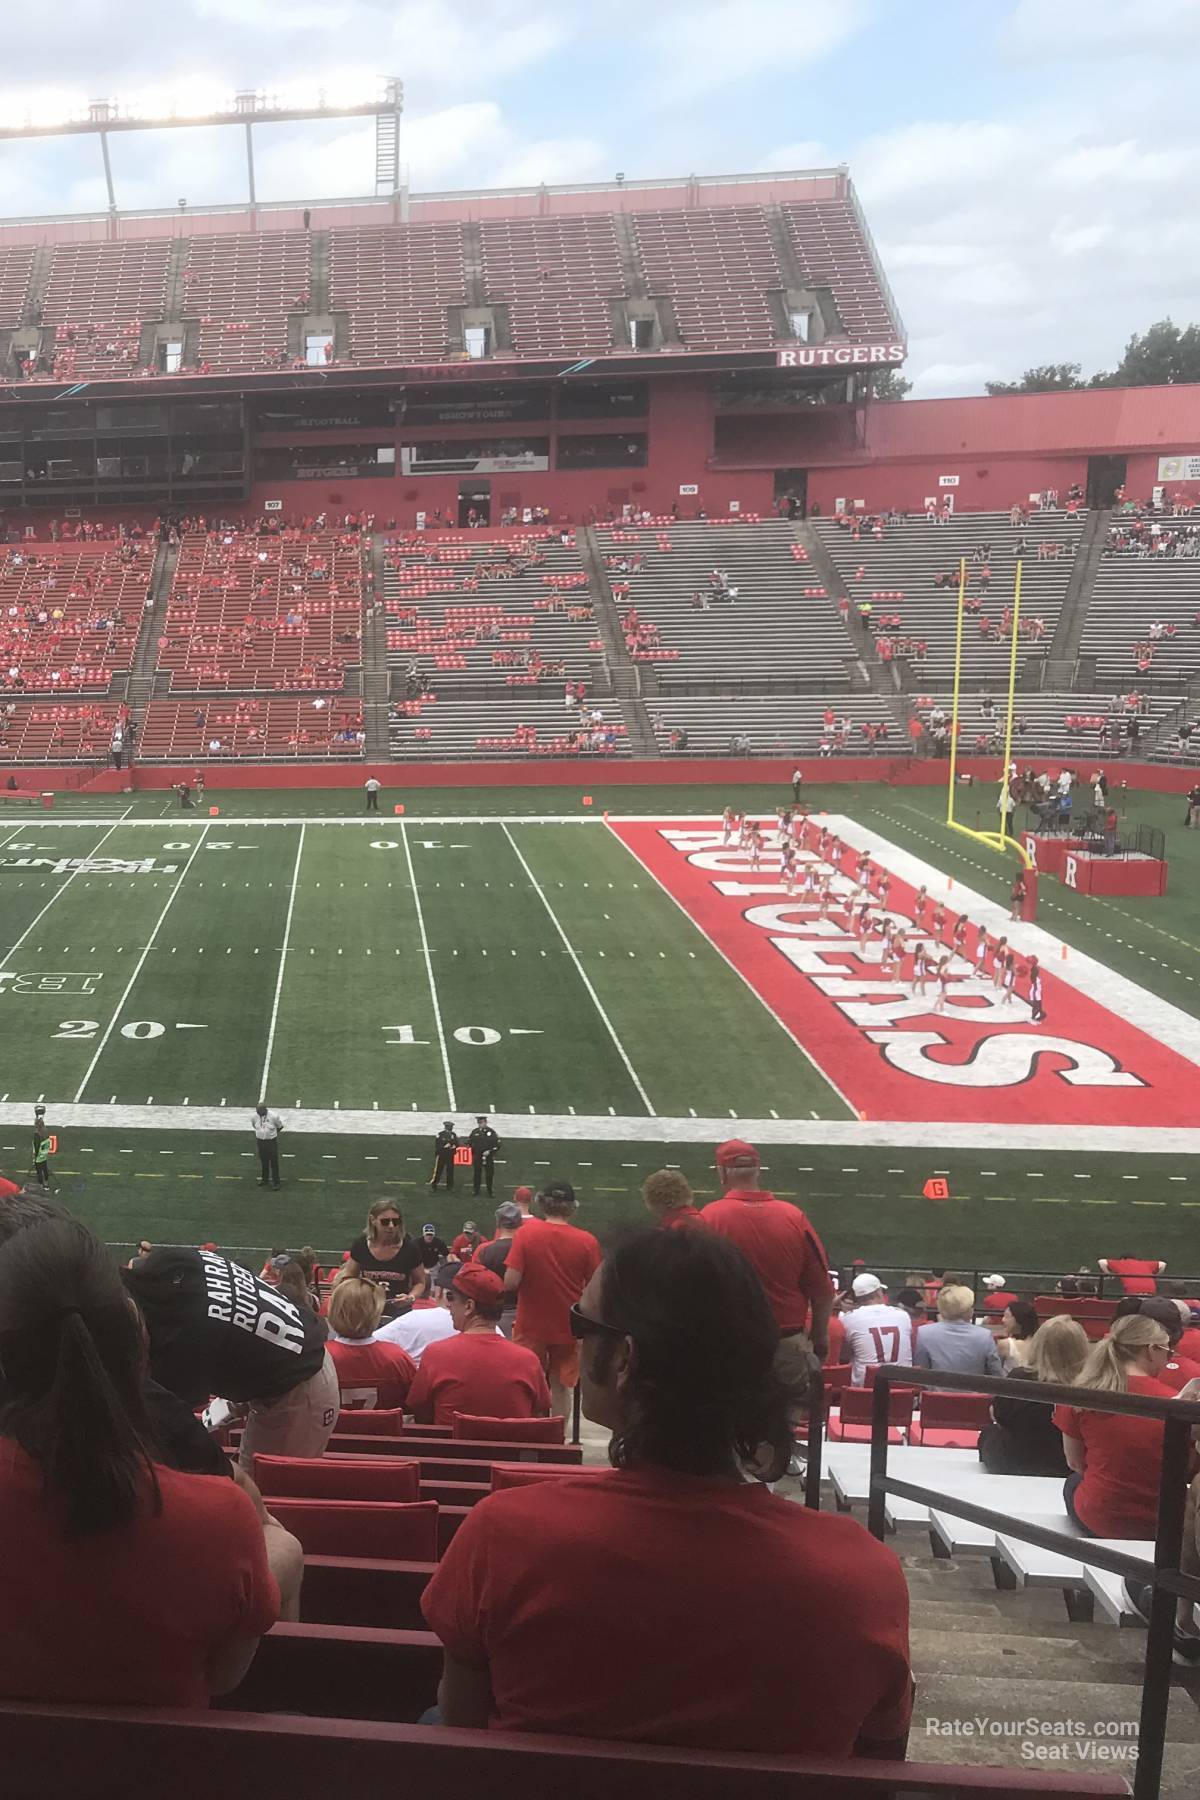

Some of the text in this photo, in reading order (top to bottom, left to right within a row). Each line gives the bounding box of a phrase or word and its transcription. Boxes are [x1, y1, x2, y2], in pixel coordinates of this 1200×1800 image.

[779, 345, 905, 367] RUTGERS
[1026, 837, 1037, 868] R
[1064, 855, 1077, 889] R
[657, 829, 1152, 1087] RUTGERS
[932, 1181, 944, 1197] G
[205, 1276, 233, 1322] RAH
[868, 1325, 901, 1364] 17
